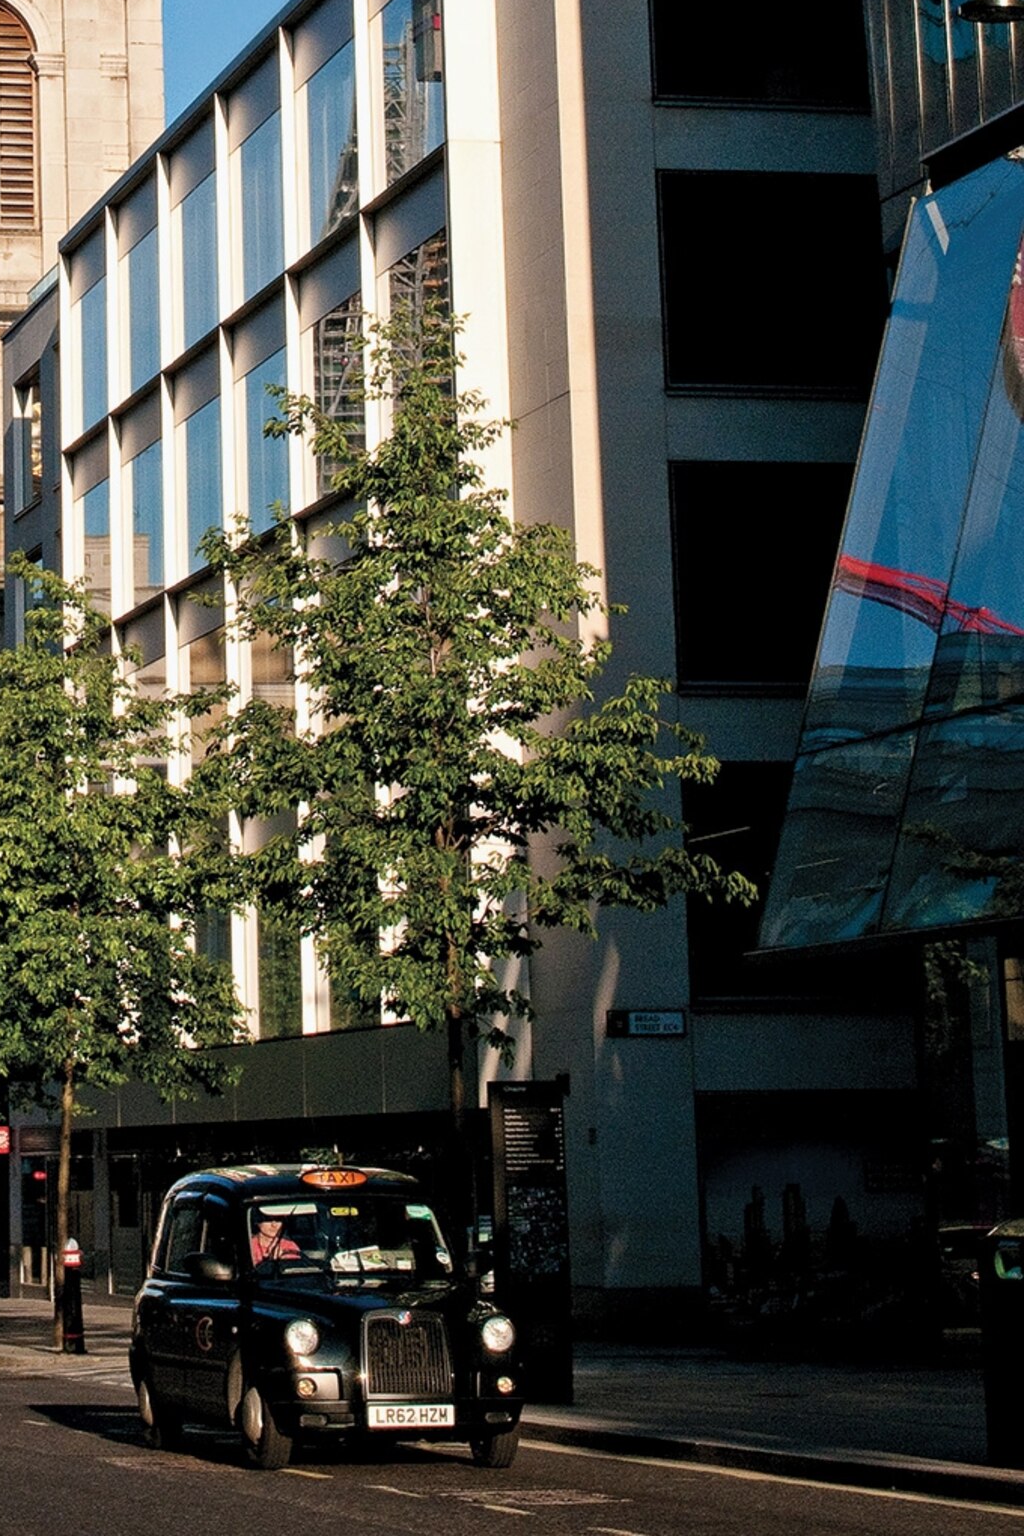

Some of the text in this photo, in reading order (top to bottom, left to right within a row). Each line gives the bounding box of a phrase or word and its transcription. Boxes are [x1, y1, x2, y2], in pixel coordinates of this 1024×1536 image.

[634, 1014, 661, 1023] BREAD
[320, 1171, 356, 1184] TAXI
[376, 1407, 448, 1424] LR62 HZM
